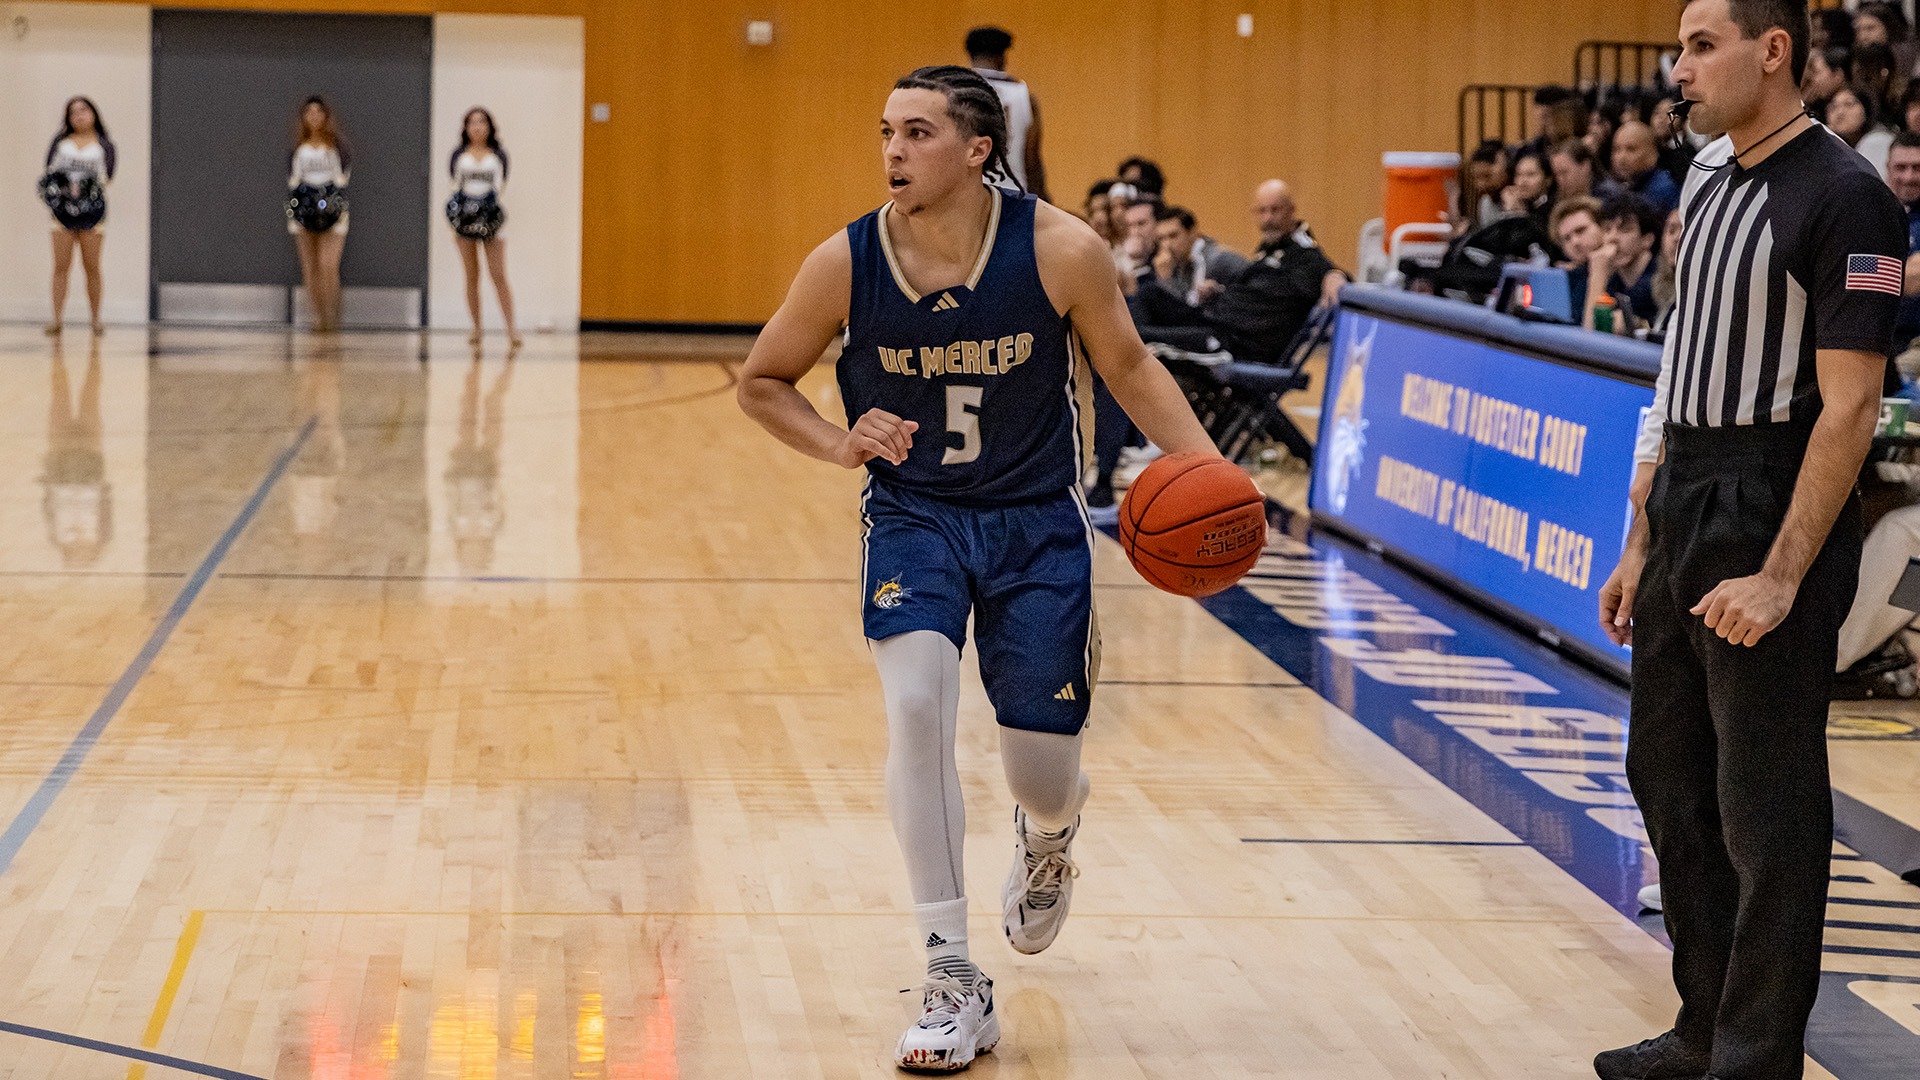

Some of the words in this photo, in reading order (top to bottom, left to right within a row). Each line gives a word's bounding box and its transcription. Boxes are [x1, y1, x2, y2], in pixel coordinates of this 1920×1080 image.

[877, 345, 917, 376] UC
[920, 332, 1034, 379] MERCED
[941, 385, 984, 466] 5
[1539, 415, 1587, 476] COURT
[1196, 525, 1263, 558] LEGACY
[1534, 519, 1593, 590] MERCED
